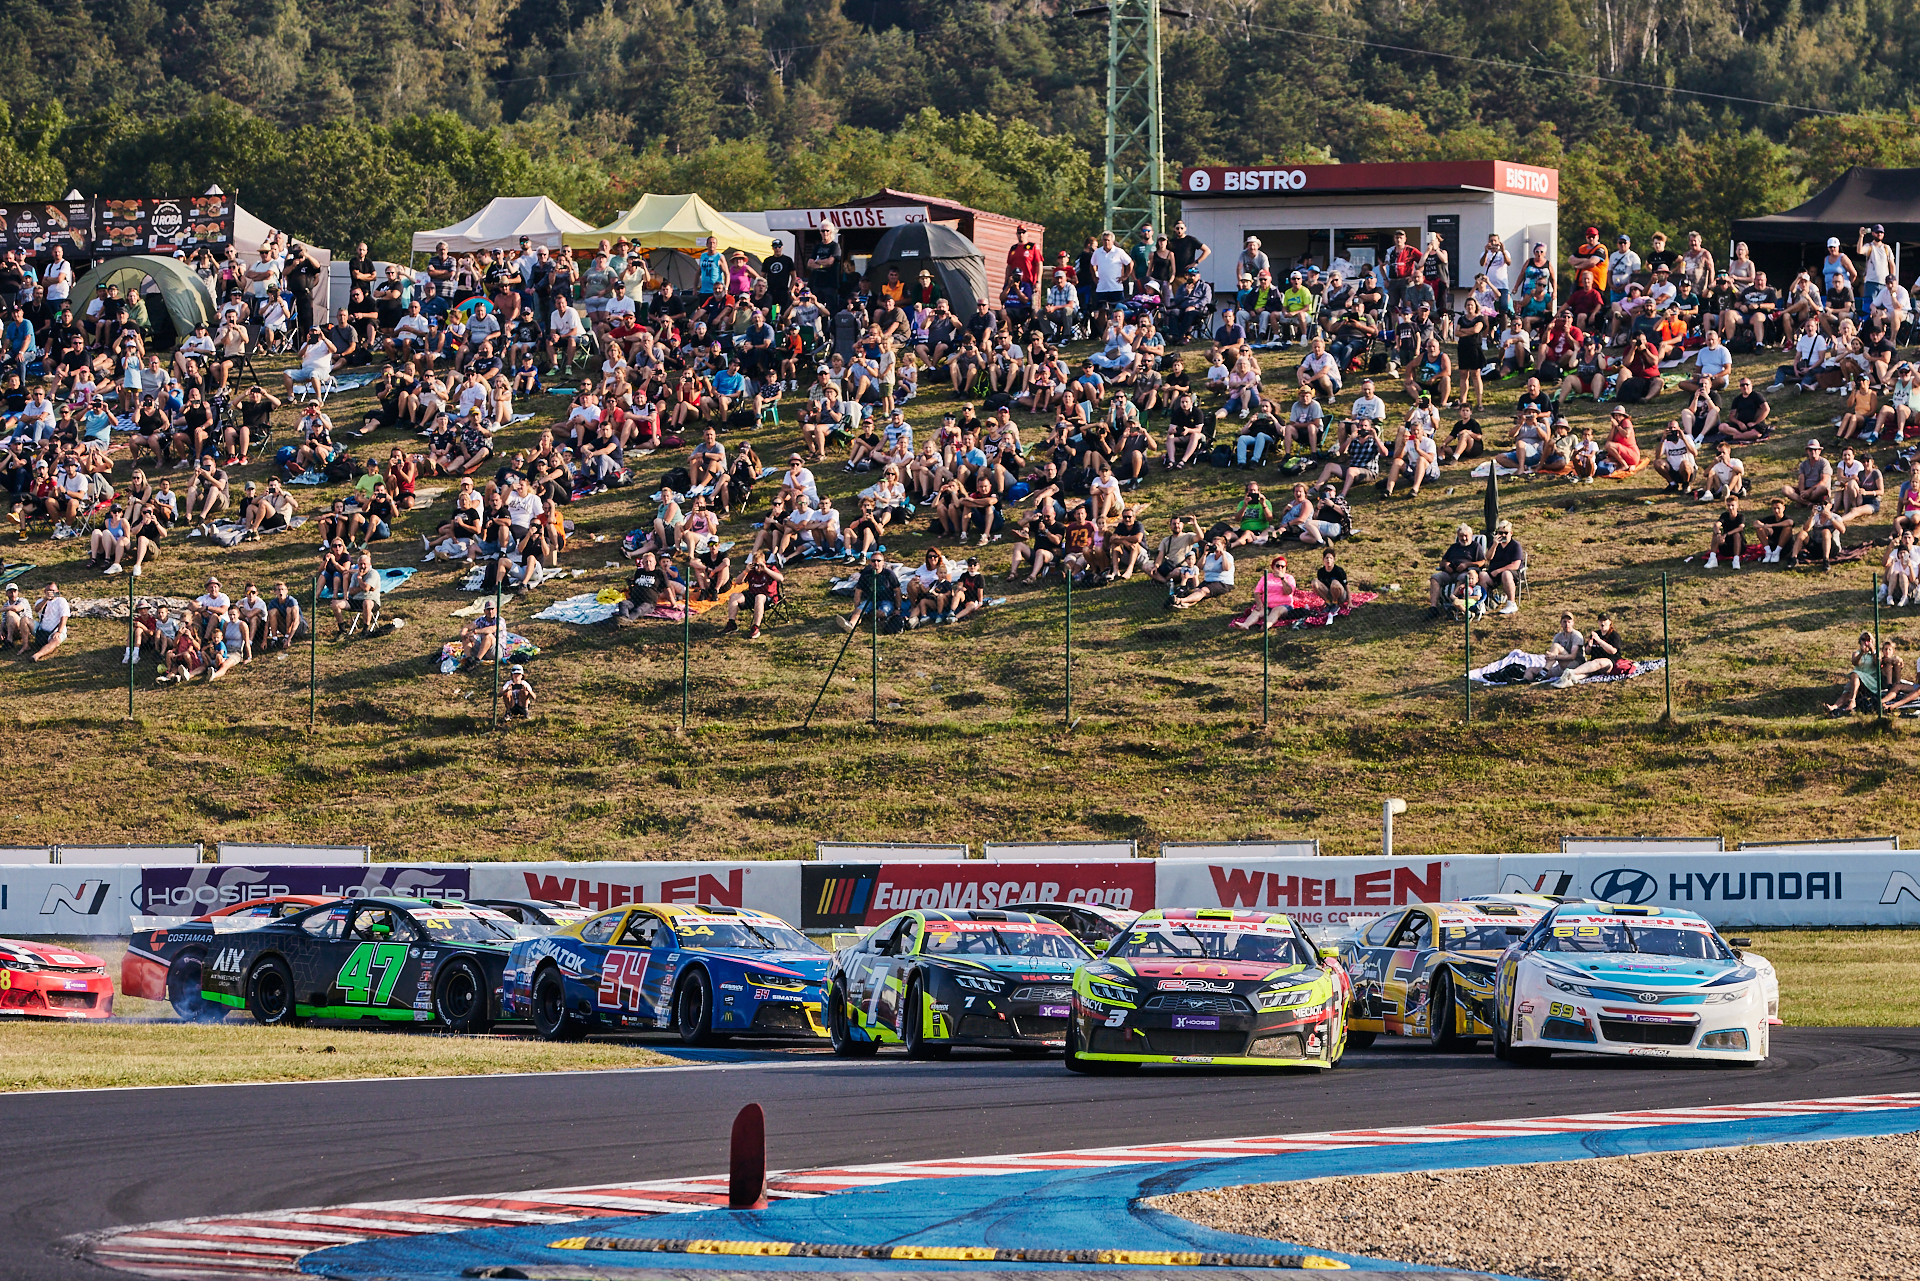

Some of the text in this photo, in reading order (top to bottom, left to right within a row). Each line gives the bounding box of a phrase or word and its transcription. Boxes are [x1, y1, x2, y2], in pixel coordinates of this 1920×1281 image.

[1195, 176, 1205, 189] 3
[1224, 169, 1307, 191] BISTRO
[1506, 167, 1549, 194] BISTRO
[159, 214, 183, 225] ROBA
[806, 208, 887, 229] LANGOŠE
[1070, 528, 1089, 548] 73
[522, 868, 744, 912] WHELEN
[1208, 861, 1442, 907] WHELEN
[1669, 871, 1842, 900] HYUNDAI
[148, 884, 291, 906] HOOSIER
[873, 881, 1134, 910] EuroNASCARcom
[426, 918, 453, 930] 47
[1586, 916, 1675, 926] WHELEN
[167, 932, 213, 944] COSTAMAR
[674, 925, 715, 937] 34
[931, 931, 953, 944] 7
[1128, 931, 1149, 945] 3
[1448, 926, 1467, 939] 5
[1552, 925, 1601, 938] 69
[211, 947, 246, 973] AIX
[537, 937, 587, 974] SIMATOK
[335, 941, 412, 1006] 47
[597, 949, 652, 1013] 34
[753, 988, 770, 1000] 34
[772, 994, 803, 1002] SIMATOK
[865, 962, 892, 1028] 7
[964, 995, 976, 1009] 7
[1104, 1009, 1129, 1027] 3
[1548, 1000, 1575, 1019] 69
